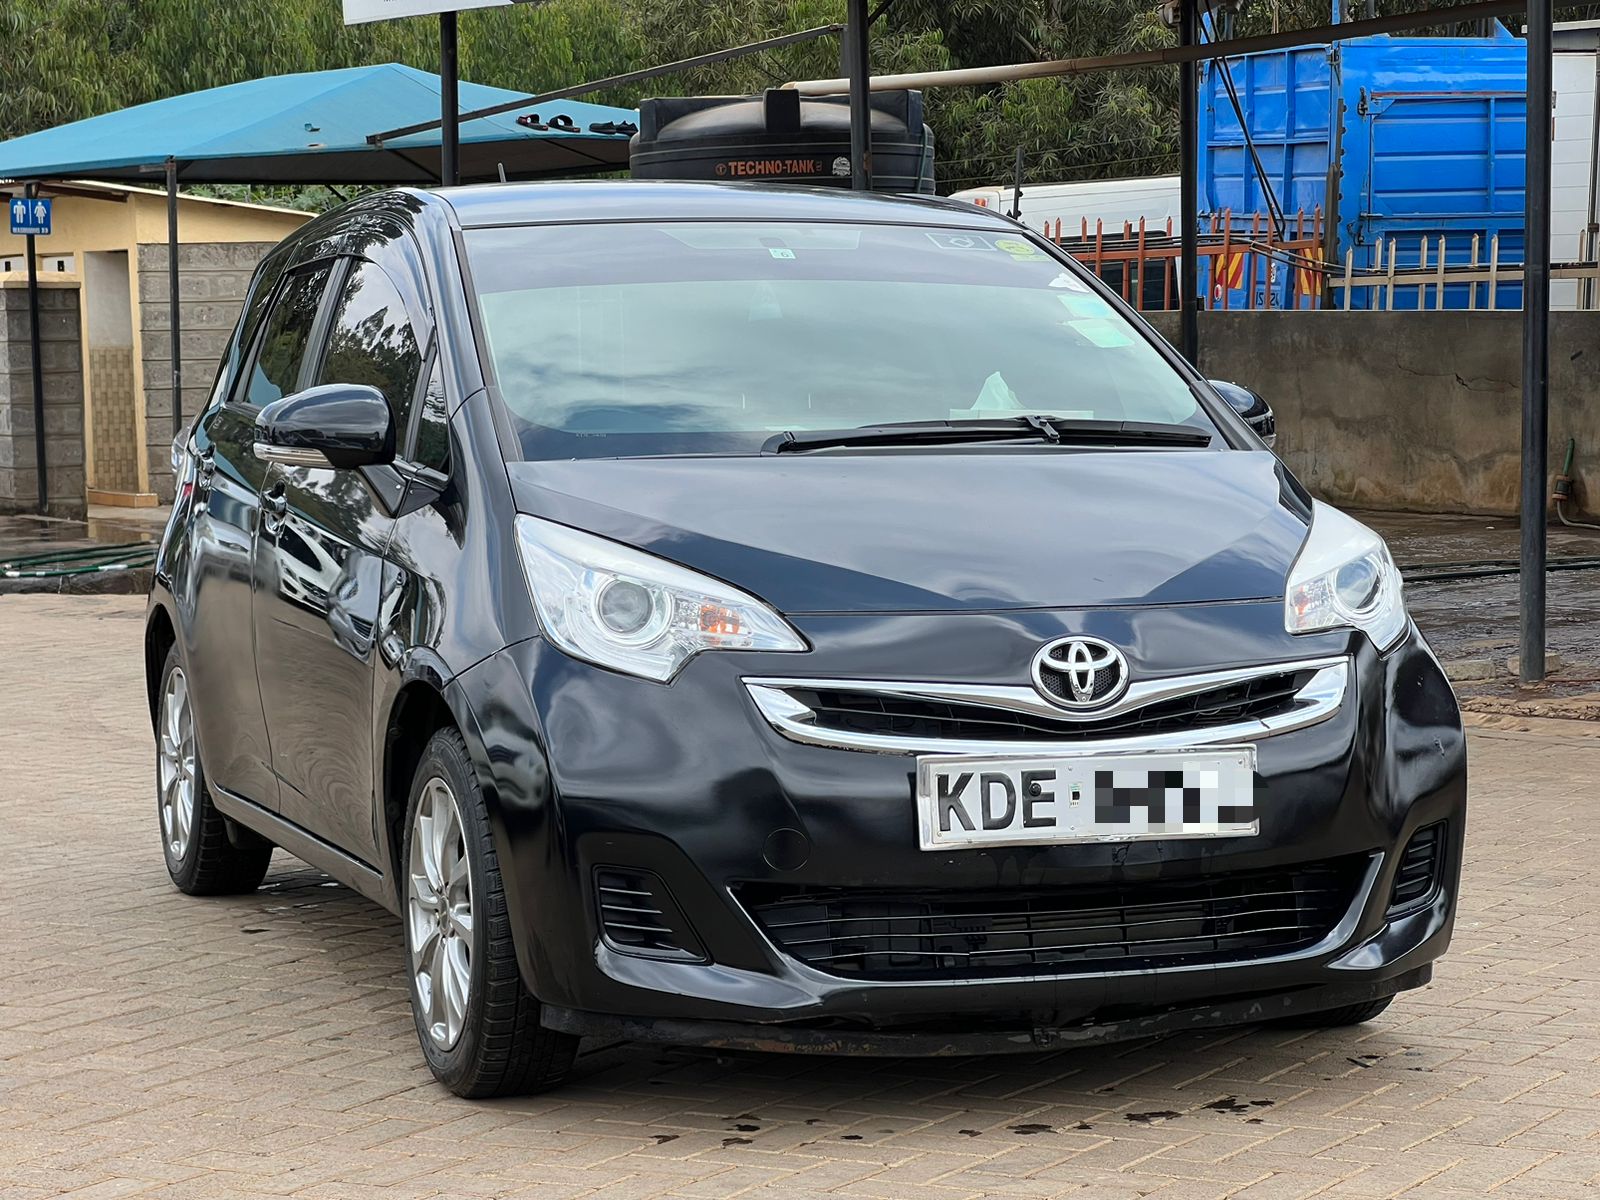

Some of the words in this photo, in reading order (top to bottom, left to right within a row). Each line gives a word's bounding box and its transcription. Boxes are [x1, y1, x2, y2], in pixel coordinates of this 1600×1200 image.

[728, 160, 815, 175] TECHNO-TANK
[1256, 292, 1280, 307] ISZ
[937, 769, 1057, 832] KDE
